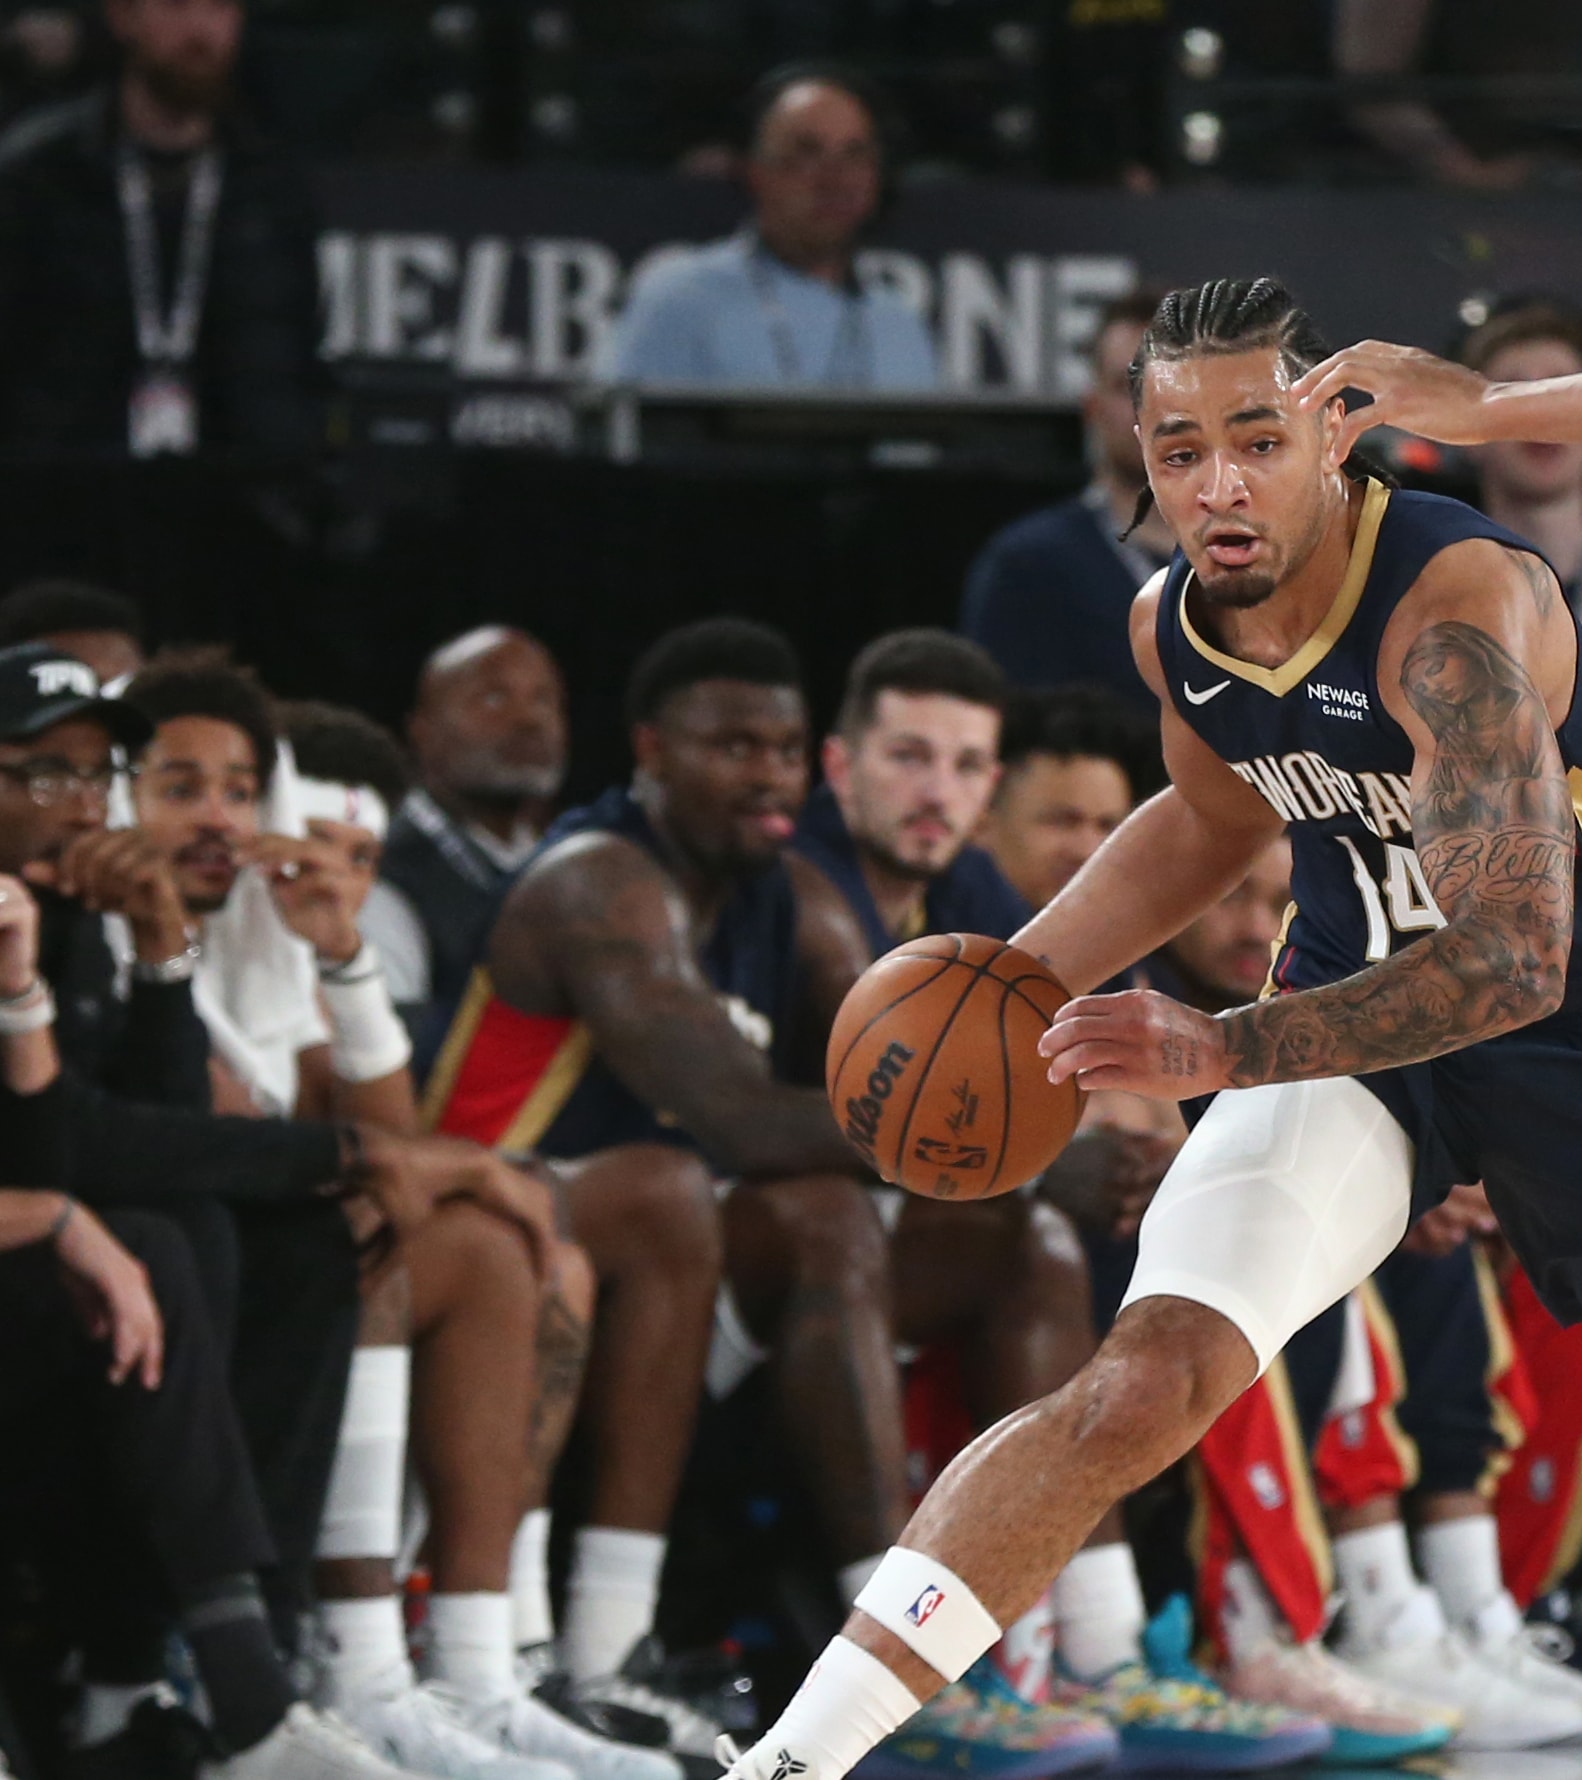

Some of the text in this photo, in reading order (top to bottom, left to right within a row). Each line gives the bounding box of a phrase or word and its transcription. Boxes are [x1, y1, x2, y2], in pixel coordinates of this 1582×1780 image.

[1306, 682, 1370, 710] NEWAGE
[1322, 704, 1364, 721] GARAGE
[1333, 835, 1449, 964] 14
[846, 1040, 916, 1166] ilson
